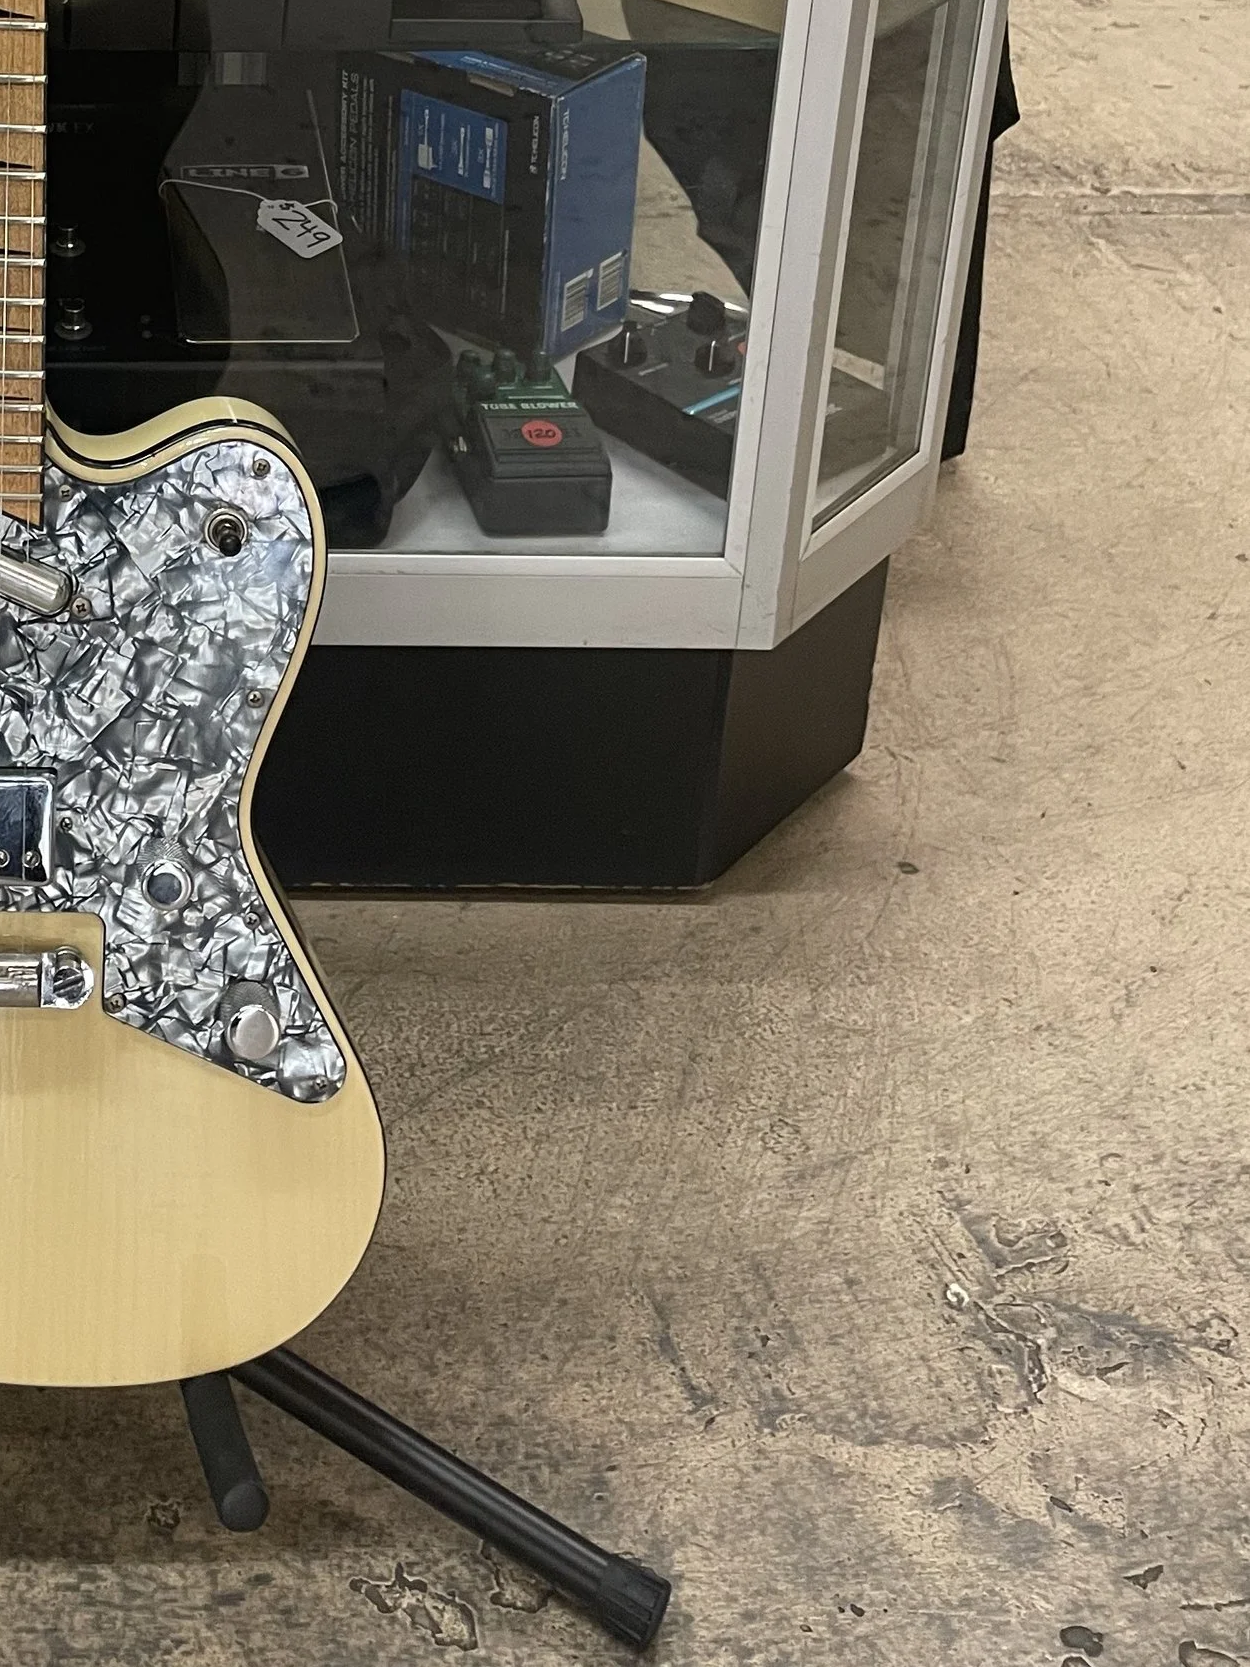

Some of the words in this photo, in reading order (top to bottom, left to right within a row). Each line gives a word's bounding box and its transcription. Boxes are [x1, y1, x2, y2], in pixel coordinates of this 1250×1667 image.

[341, 69, 349, 89] KIT
[350, 72, 360, 134] PEDALS
[188, 167, 271, 178] LINE
[519, 401, 579, 409] BLOWER
[527, 428, 557, 439] 120
